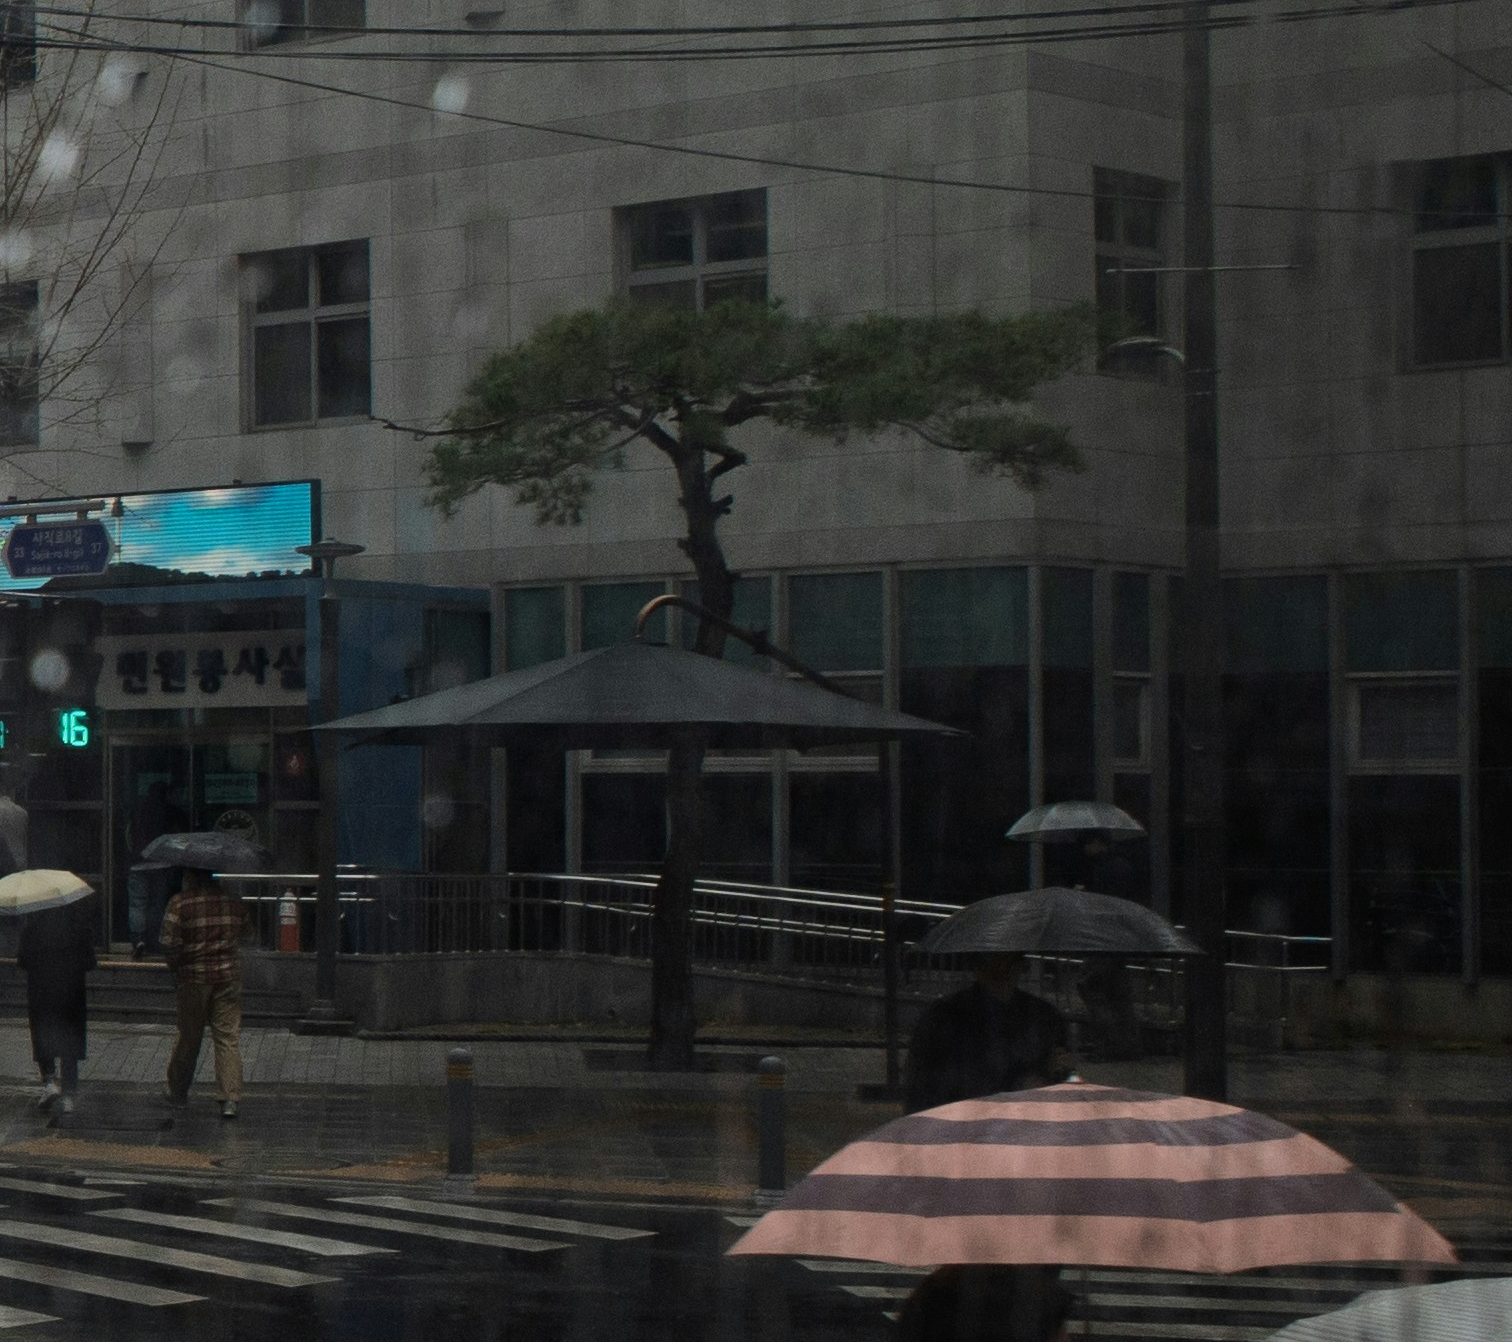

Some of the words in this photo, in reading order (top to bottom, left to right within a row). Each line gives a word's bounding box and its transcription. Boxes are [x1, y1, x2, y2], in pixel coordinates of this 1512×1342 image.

[32, 528, 83, 546] 사직로8길
[117, 644, 306, 694] 민원봉사실
[60, 711, 88, 747] 16
